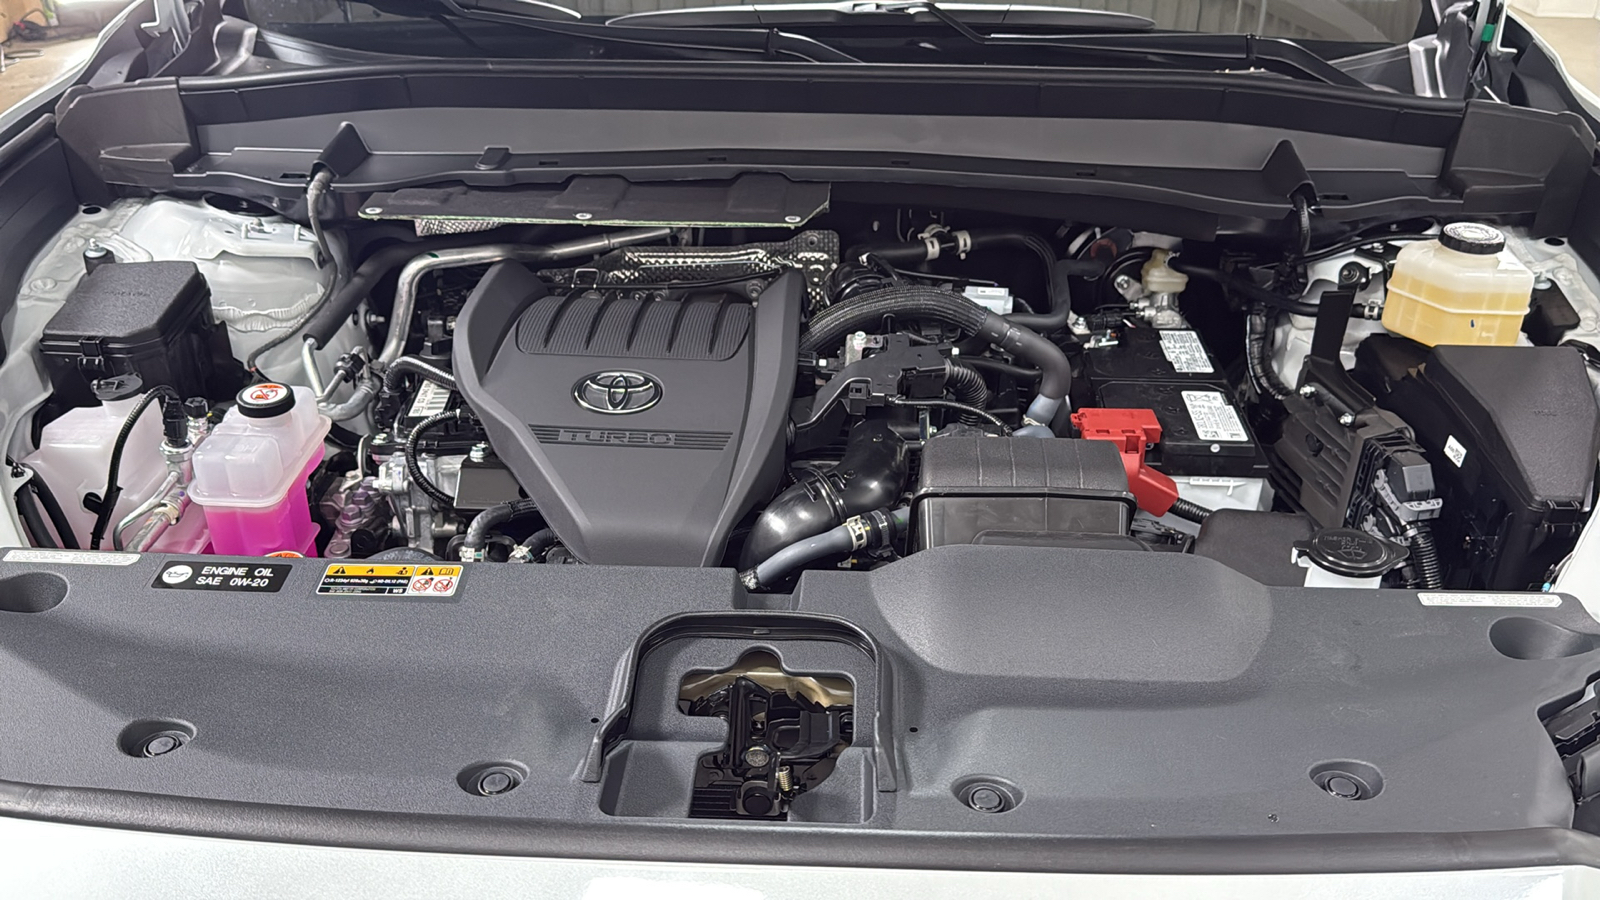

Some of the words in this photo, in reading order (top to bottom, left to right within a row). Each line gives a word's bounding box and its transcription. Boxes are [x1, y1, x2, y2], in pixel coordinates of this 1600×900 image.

[562, 430, 672, 445] TURBO
[201, 566, 249, 576] ENGINE
[254, 567, 274, 577] OIL
[195, 576, 223, 586] SAE
[229, 577, 269, 587] 0W-20
